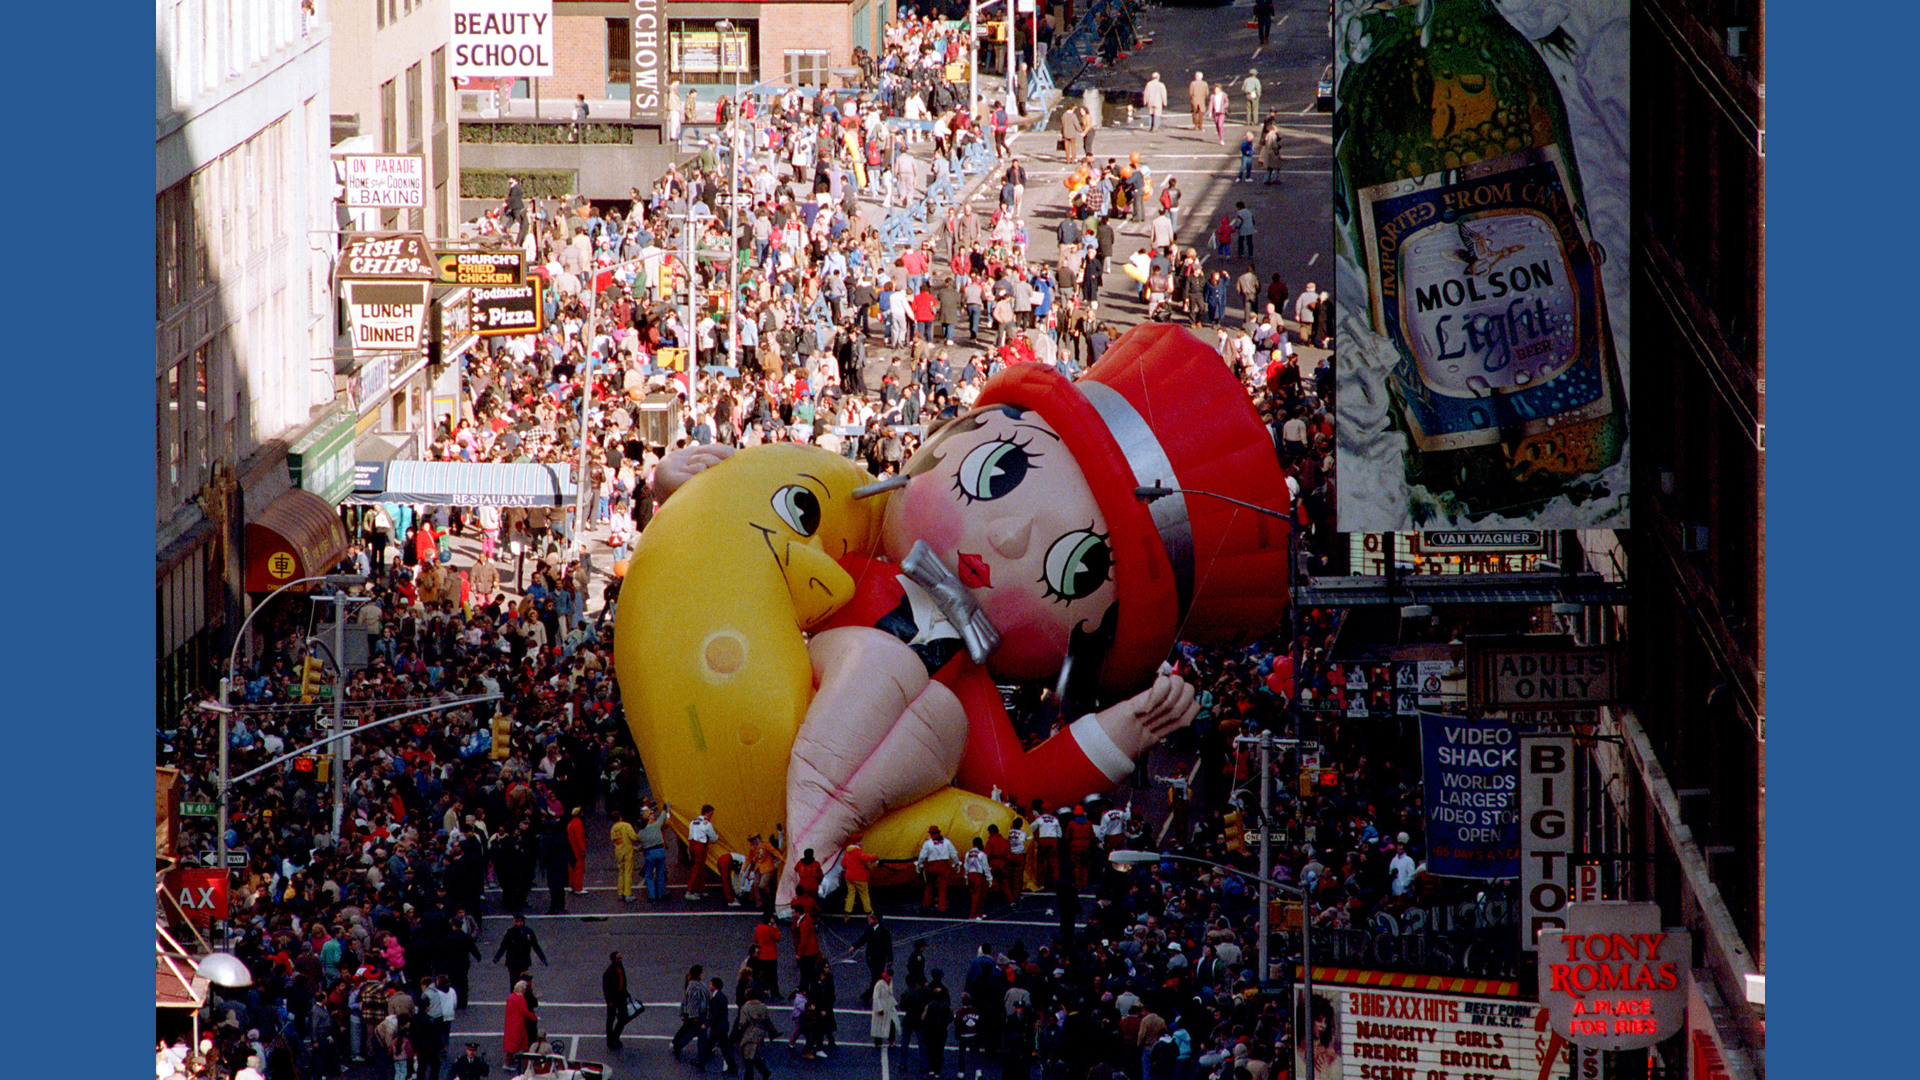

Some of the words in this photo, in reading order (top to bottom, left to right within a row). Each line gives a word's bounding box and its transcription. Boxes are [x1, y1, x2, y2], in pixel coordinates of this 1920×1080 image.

[454, 13, 548, 35] BEAUTY
[456, 44, 549, 67] SCHOOL
[353, 159, 366, 174] ON
[375, 159, 415, 174] PARADE
[361, 190, 419, 204] BAKING
[349, 236, 405, 258] FISH
[408, 241, 418, 255] &
[1379, 202, 1436, 298] IMPORTED
[1443, 182, 1512, 216] FROM
[350, 254, 421, 275] CHIPS
[458, 255, 519, 265] CHURCH'S
[458, 264, 496, 274] FRIED
[458, 273, 513, 284] CHICKEN
[1415, 260, 1553, 312] MOLSON
[361, 304, 413, 319] LUNCH
[488, 307, 536, 326] Pizza
[361, 325, 414, 342] DINNER
[1435, 297, 1556, 372] Light
[1516, 340, 1553, 361] BEER
[452, 494, 535, 505] RESTAURANT
[1439, 534, 1468, 545] VAN
[1469, 534, 1531, 545] WAGNER
[272, 553, 292, 578] 車
[1500, 656, 1607, 677] ADULTS
[1516, 679, 1592, 699] ONLY
[1443, 726, 1512, 745] VIDEO
[1437, 746, 1518, 768] SHACK
[1442, 772, 1516, 791] WORLDS
[1440, 789, 1518, 808] LARGEST
[1530, 745, 1566, 839] BIG
[187, 804, 194, 813] W
[195, 804, 207, 814] 49
[1431, 805, 1476, 825] VIDEO
[1246, 833, 1261, 841] ONE
[1457, 827, 1501, 843] OPEN
[1453, 848, 1483, 861] DAYS
[1487, 850, 1496, 861] A
[1561, 933, 1668, 961] TONY
[1549, 963, 1679, 999] ROMAS
[1349, 993, 1359, 1016] 3
[1361, 993, 1384, 1018] BIG
[1386, 996, 1422, 1020] XXX
[1423, 998, 1458, 1022] HITS
[1464, 1001, 1495, 1015] BEST
[1499, 1003, 1532, 1018] PORN
[1573, 1001, 1587, 1015] A
[1595, 1000, 1653, 1015] PLACE
[1471, 1014, 1484, 1025] IN
[1486, 1016, 1523, 1029] N.Y.C.
[1571, 1020, 1607, 1035] FOR
[1615, 1020, 1657, 1035] RIBS
[1356, 1021, 1437, 1043] NAUGHTY
[1455, 1030, 1504, 1048] GIRLS
[1353, 1043, 1418, 1063] FRENCH
[1440, 1051, 1512, 1070] EROTICA
[1360, 1064, 1416, 1080] SCENT
